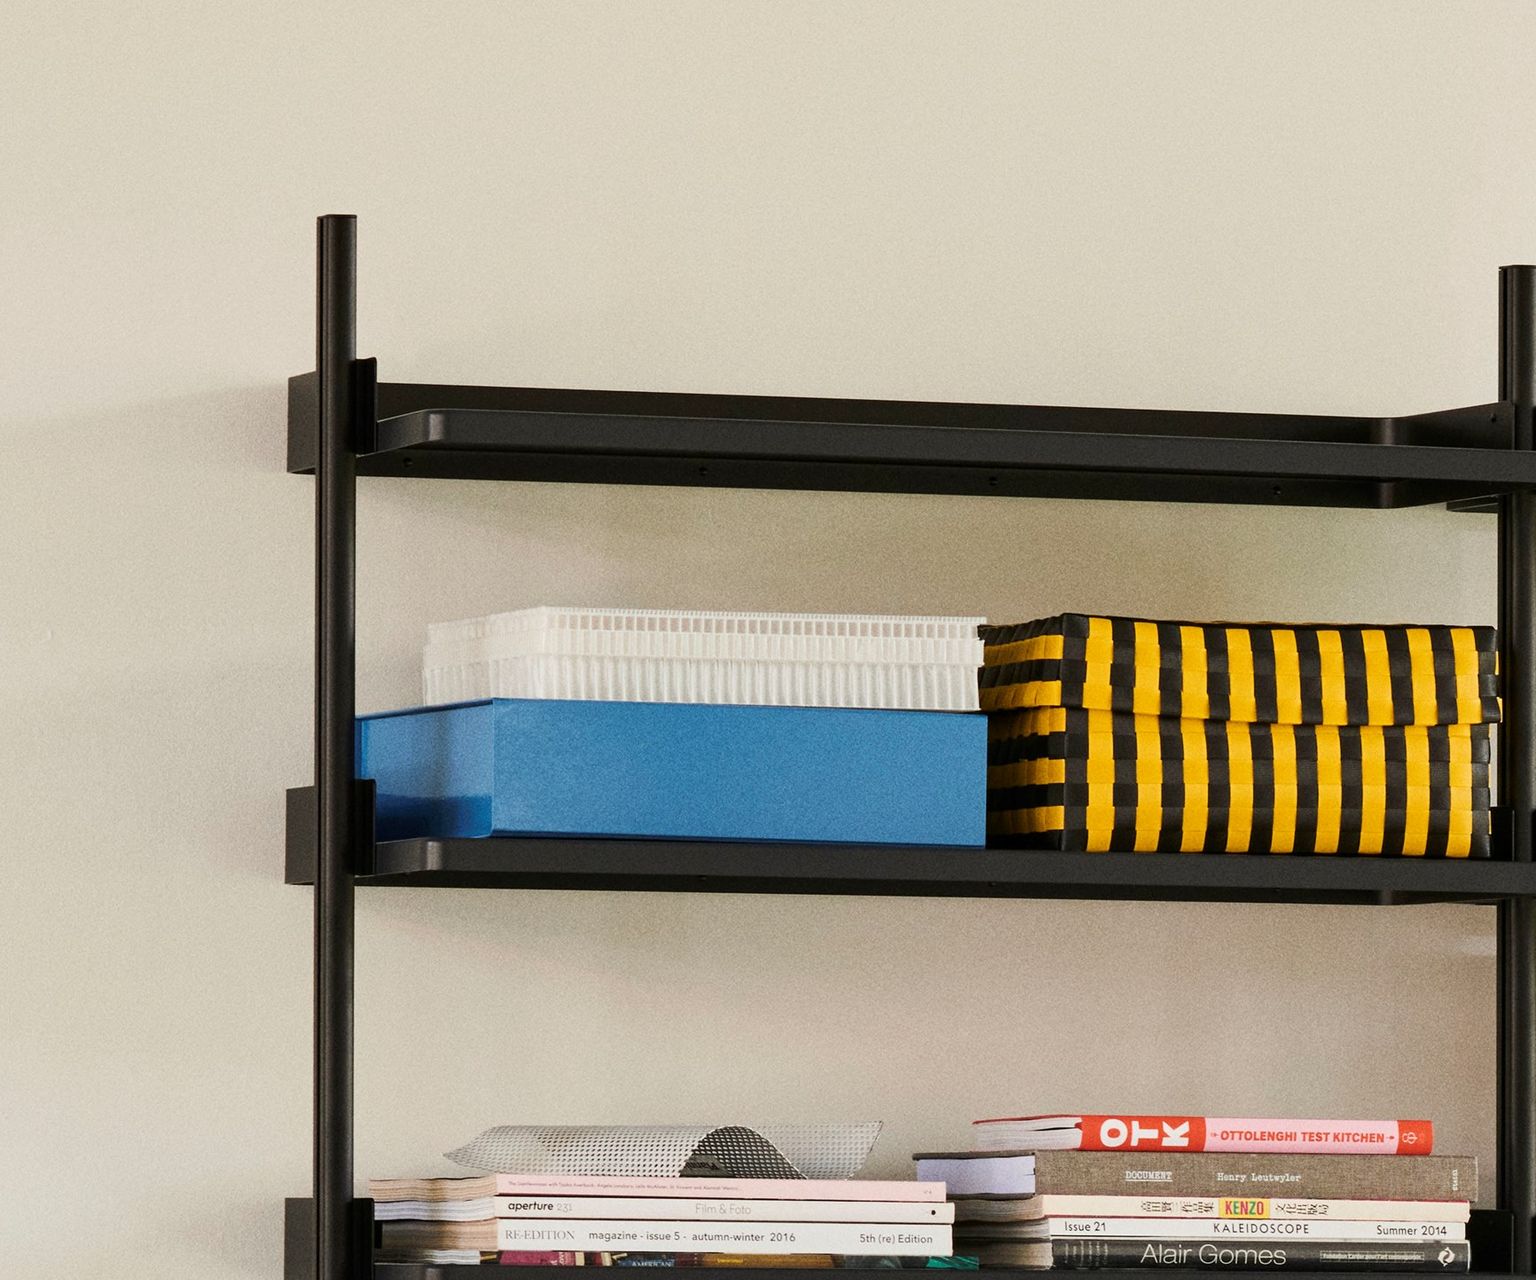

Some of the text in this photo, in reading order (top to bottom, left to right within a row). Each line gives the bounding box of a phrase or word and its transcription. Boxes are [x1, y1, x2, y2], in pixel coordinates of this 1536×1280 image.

[1100, 1118, 1190, 1147] OTK
[1220, 1130, 1385, 1143] OTTOLENGHI TEST KITCHEN
[1125, 1171, 1301, 1184] DOCUMENT Henry Leutwyler
[508, 1201, 752, 1215] aperture 231 Film & Foto
[1225, 1200, 1264, 1215] KENZO
[1064, 1221, 1448, 1236] Issue 21 KALEIDOSCOPE Summer 2014
[505, 1230, 575, 1241] RE-EDITION
[588, 1232, 637, 1242] magazine
[646, 1231, 672, 1241] issue
[674, 1231, 680, 1241] 5
[692, 1232, 764, 1242] autumn-winter
[770, 1232, 796, 1242] 2016
[860, 1233, 876, 1243] 5th
[878, 1233, 895, 1245] (re)
[898, 1233, 933, 1244] Edition
[1140, 1244, 1287, 1266] Alair Gomes
